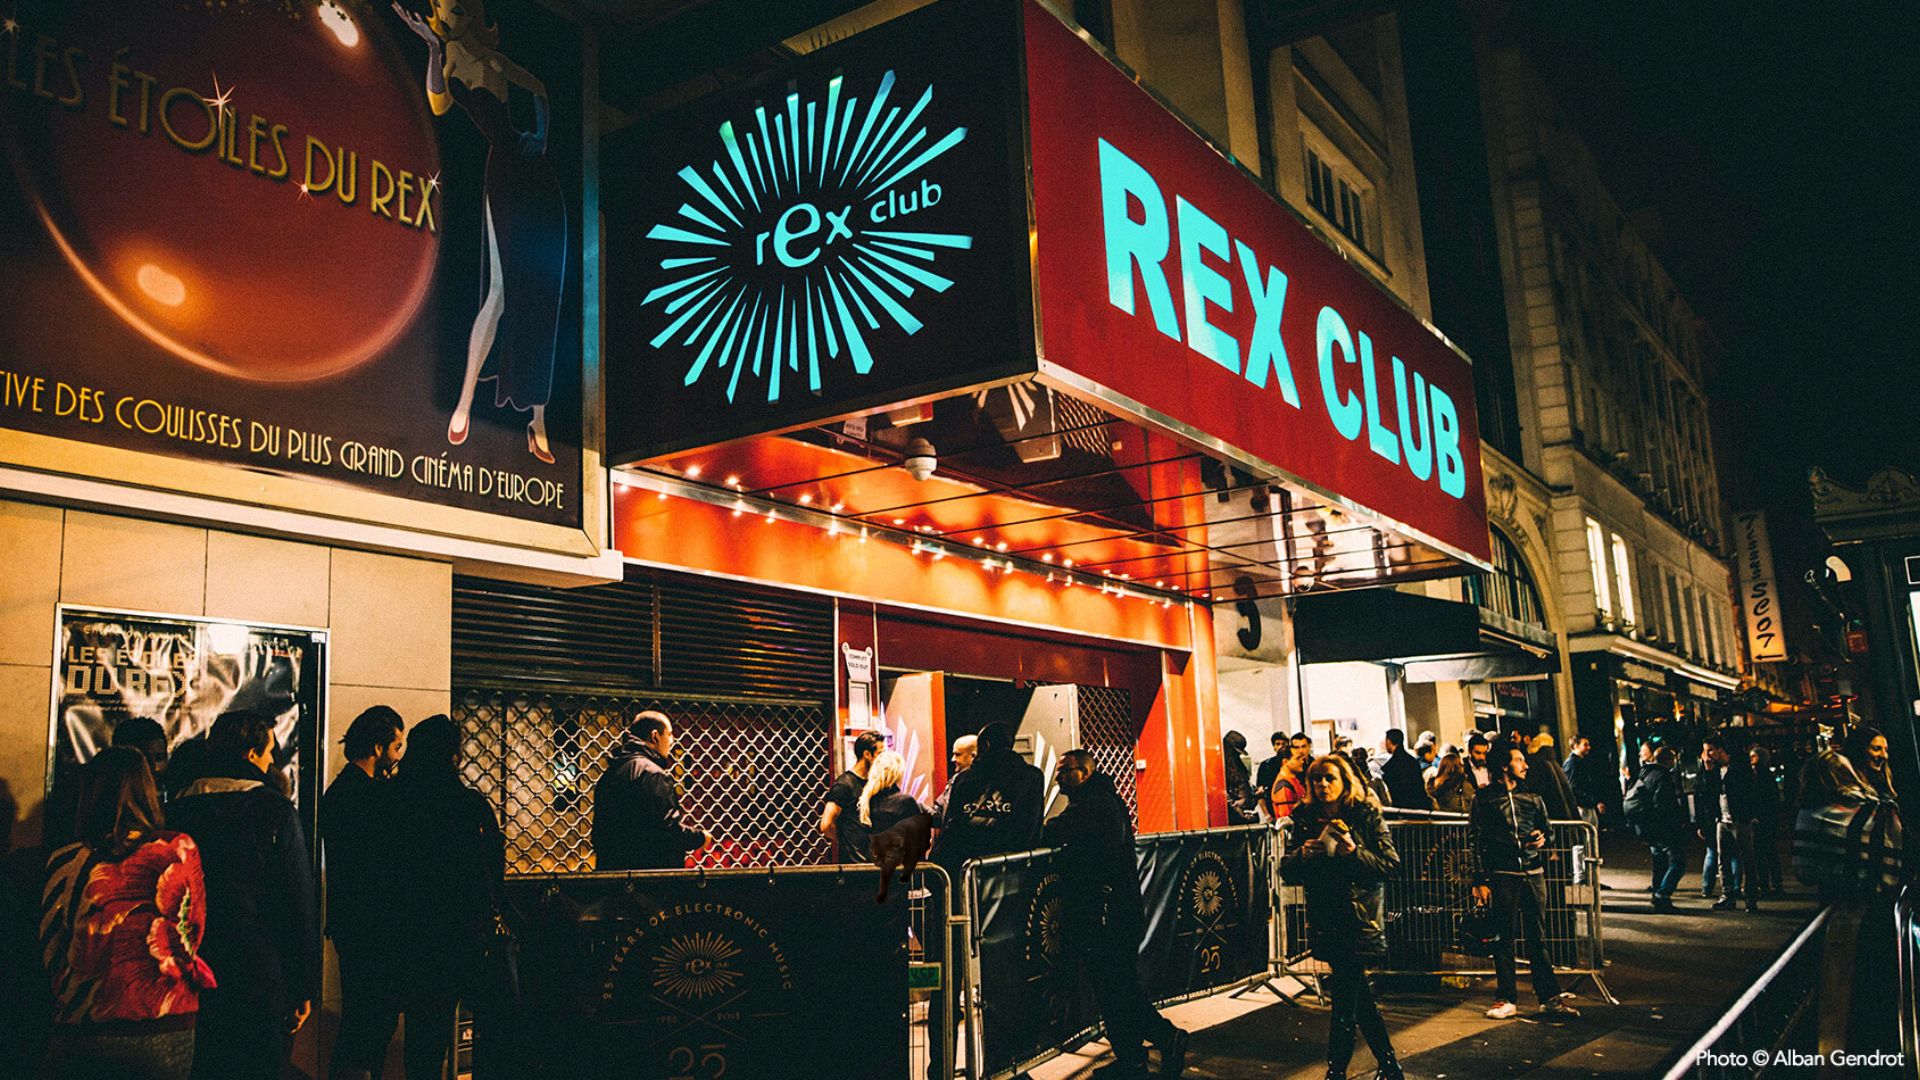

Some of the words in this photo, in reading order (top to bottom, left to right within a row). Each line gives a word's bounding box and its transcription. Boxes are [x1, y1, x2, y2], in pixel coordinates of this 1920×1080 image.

[8, 33, 85, 106] LES
[108, 47, 288, 177] ÉTOILES
[305, 134, 358, 203] DU
[371, 160, 437, 232] REX
[756, 202, 854, 268] rex
[870, 179, 942, 224] club
[1098, 136, 1301, 410] REX
[1316, 306, 1466, 499] CLUB
[55, 382, 104, 423] DES
[115, 396, 242, 449] COULISSES
[250, 421, 280, 456] DU
[287, 429, 332, 466] PLUS
[340, 441, 404, 478] GRAND
[411, 451, 473, 492] CINÉMA
[479, 467, 565, 509] D'EUROPE
[608, 927, 645, 973] YEARS
[649, 910, 670, 927] OF
[674, 903, 769, 939] ELECTRONIC
[768, 942, 792, 991] MUSIC
